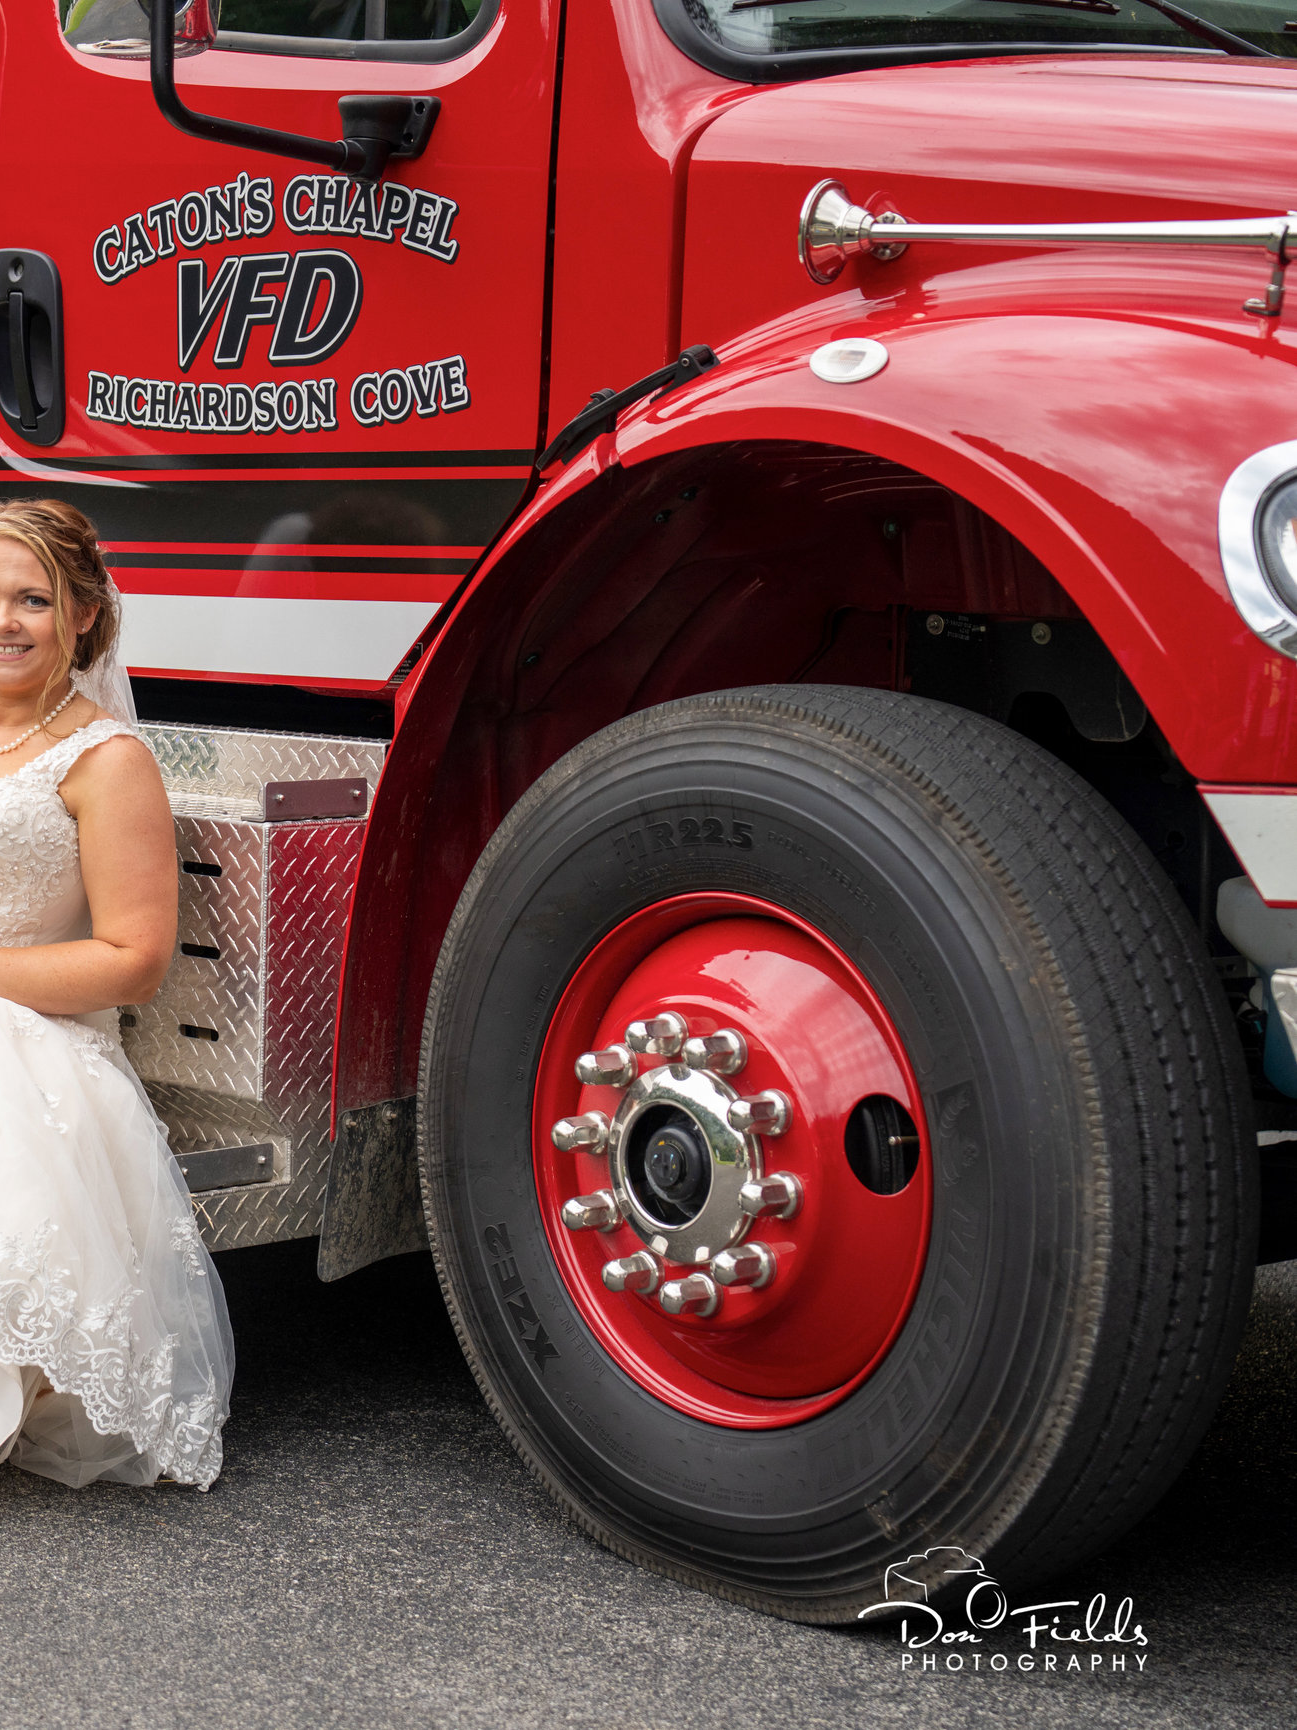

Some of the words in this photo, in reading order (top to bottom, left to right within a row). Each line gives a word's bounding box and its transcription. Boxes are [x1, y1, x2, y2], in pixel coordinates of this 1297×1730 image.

[93, 171, 275, 286] CATON'S
[283, 174, 460, 265] CHAPEL
[176, 248, 364, 373] VFD
[86, 370, 339, 436] RICHARDSON
[350, 355, 472, 427] COVE
[809, 1203, 980, 1490] MICHELIN
